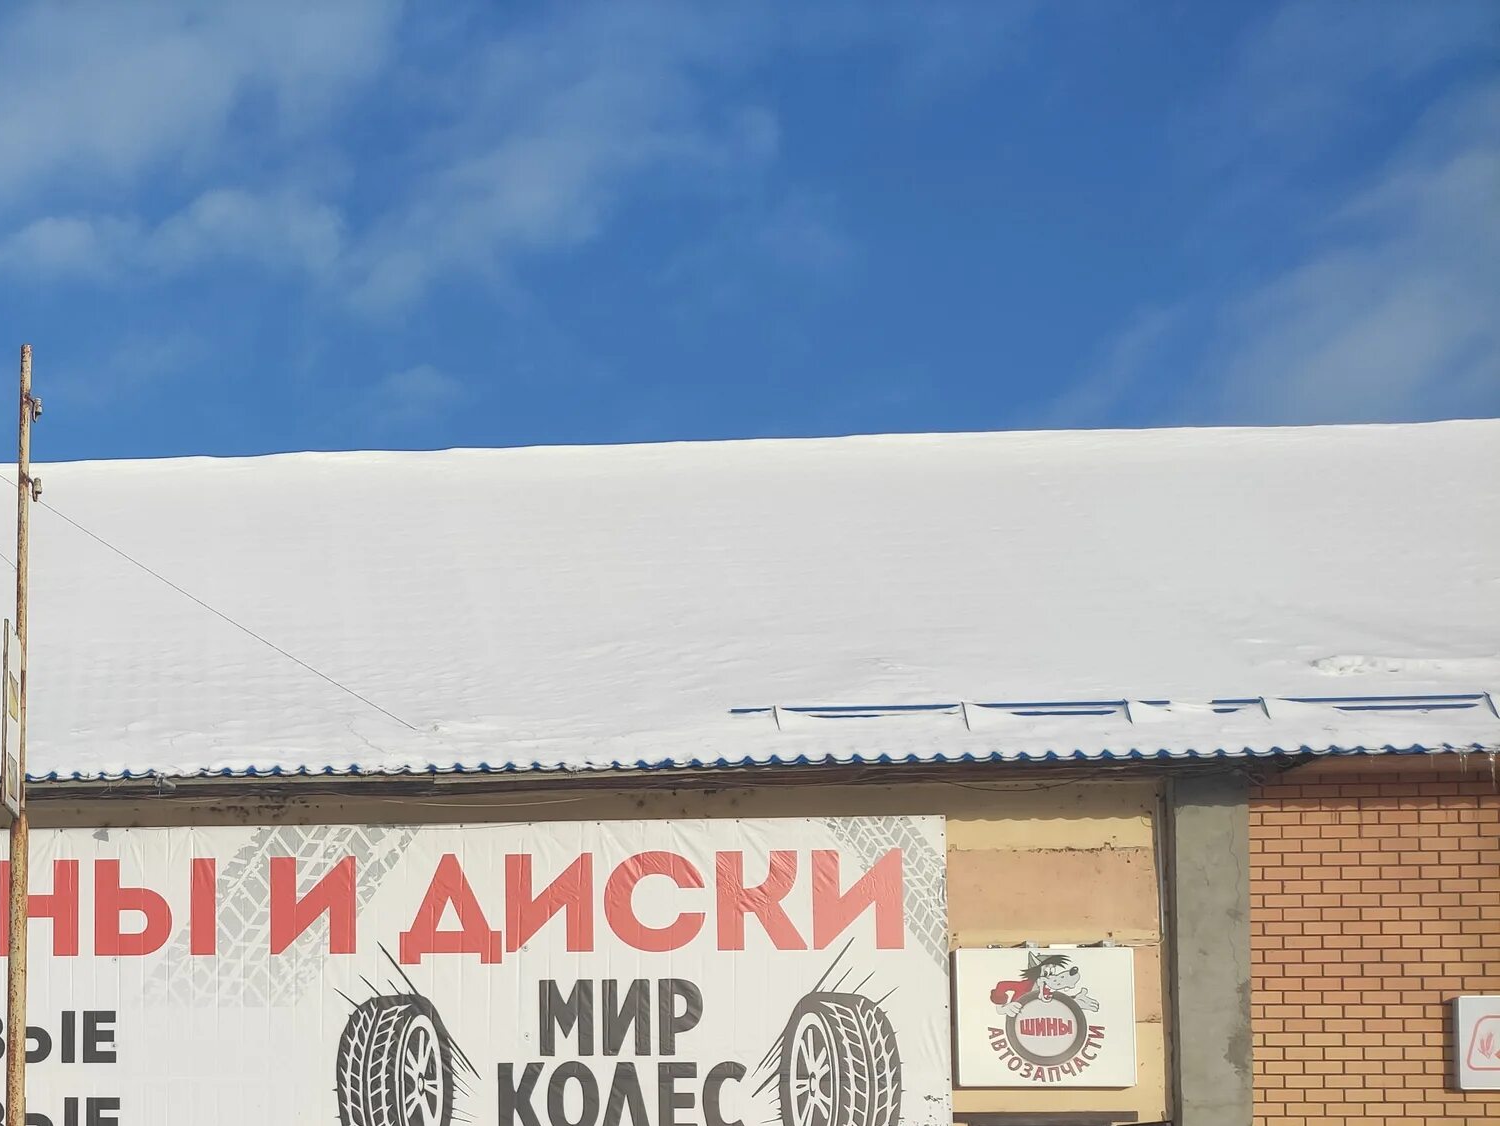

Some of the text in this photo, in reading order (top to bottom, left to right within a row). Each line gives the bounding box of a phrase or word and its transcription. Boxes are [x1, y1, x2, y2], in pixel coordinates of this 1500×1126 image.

[270, 856, 357, 955] И
[400, 848, 905, 965] ДИСКИ
[538, 978, 703, 1057] МИР
[1019, 1016, 1073, 1037] ШИНЫ
[987, 1024, 1106, 1083] АВТОЗАПЧАСТИ
